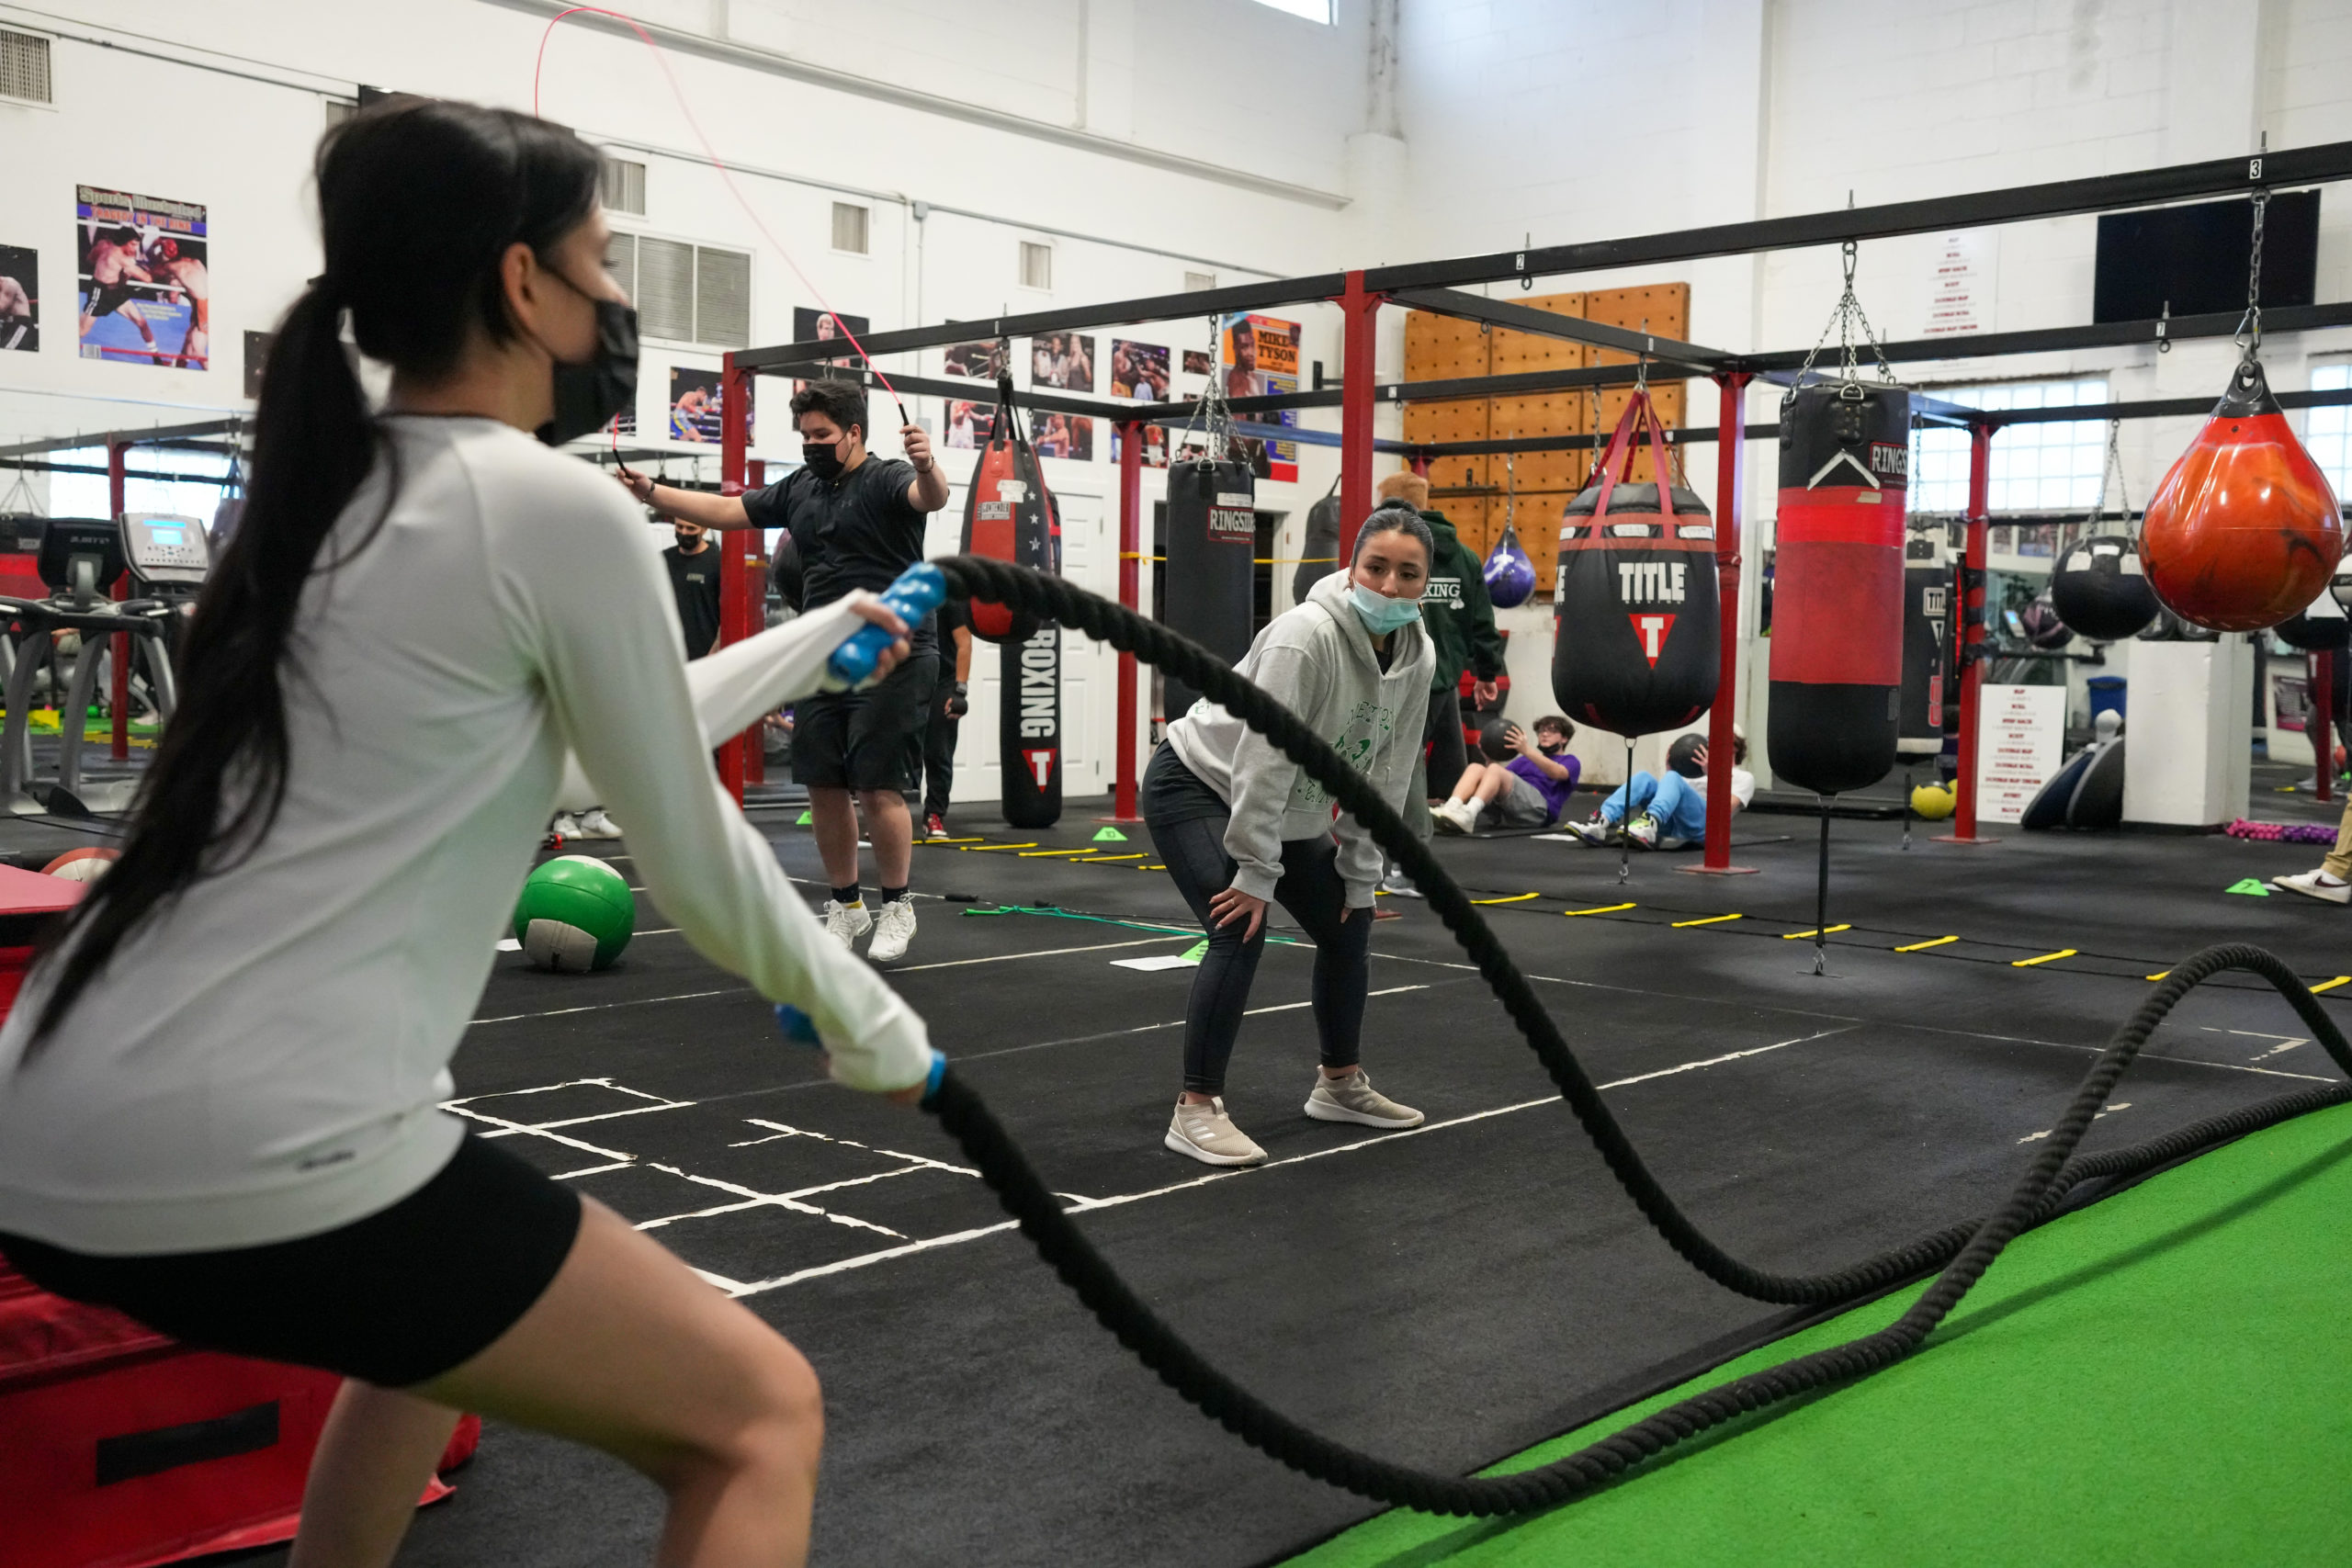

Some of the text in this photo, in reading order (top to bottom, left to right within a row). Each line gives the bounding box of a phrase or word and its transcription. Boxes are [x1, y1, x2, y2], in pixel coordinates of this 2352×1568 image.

[2252, 161, 2259, 176] 3
[80, 186, 202, 220] Sports Illustrated
[91, 205, 134, 221] TRAGEDY
[169, 218, 191, 231] RING
[1258, 344, 1295, 363] TYSON
[1619, 562, 1685, 601] TITLE
[1641, 617, 1664, 658] T
[1021, 629, 1057, 738] BOXING
[1032, 752, 1050, 786] T
